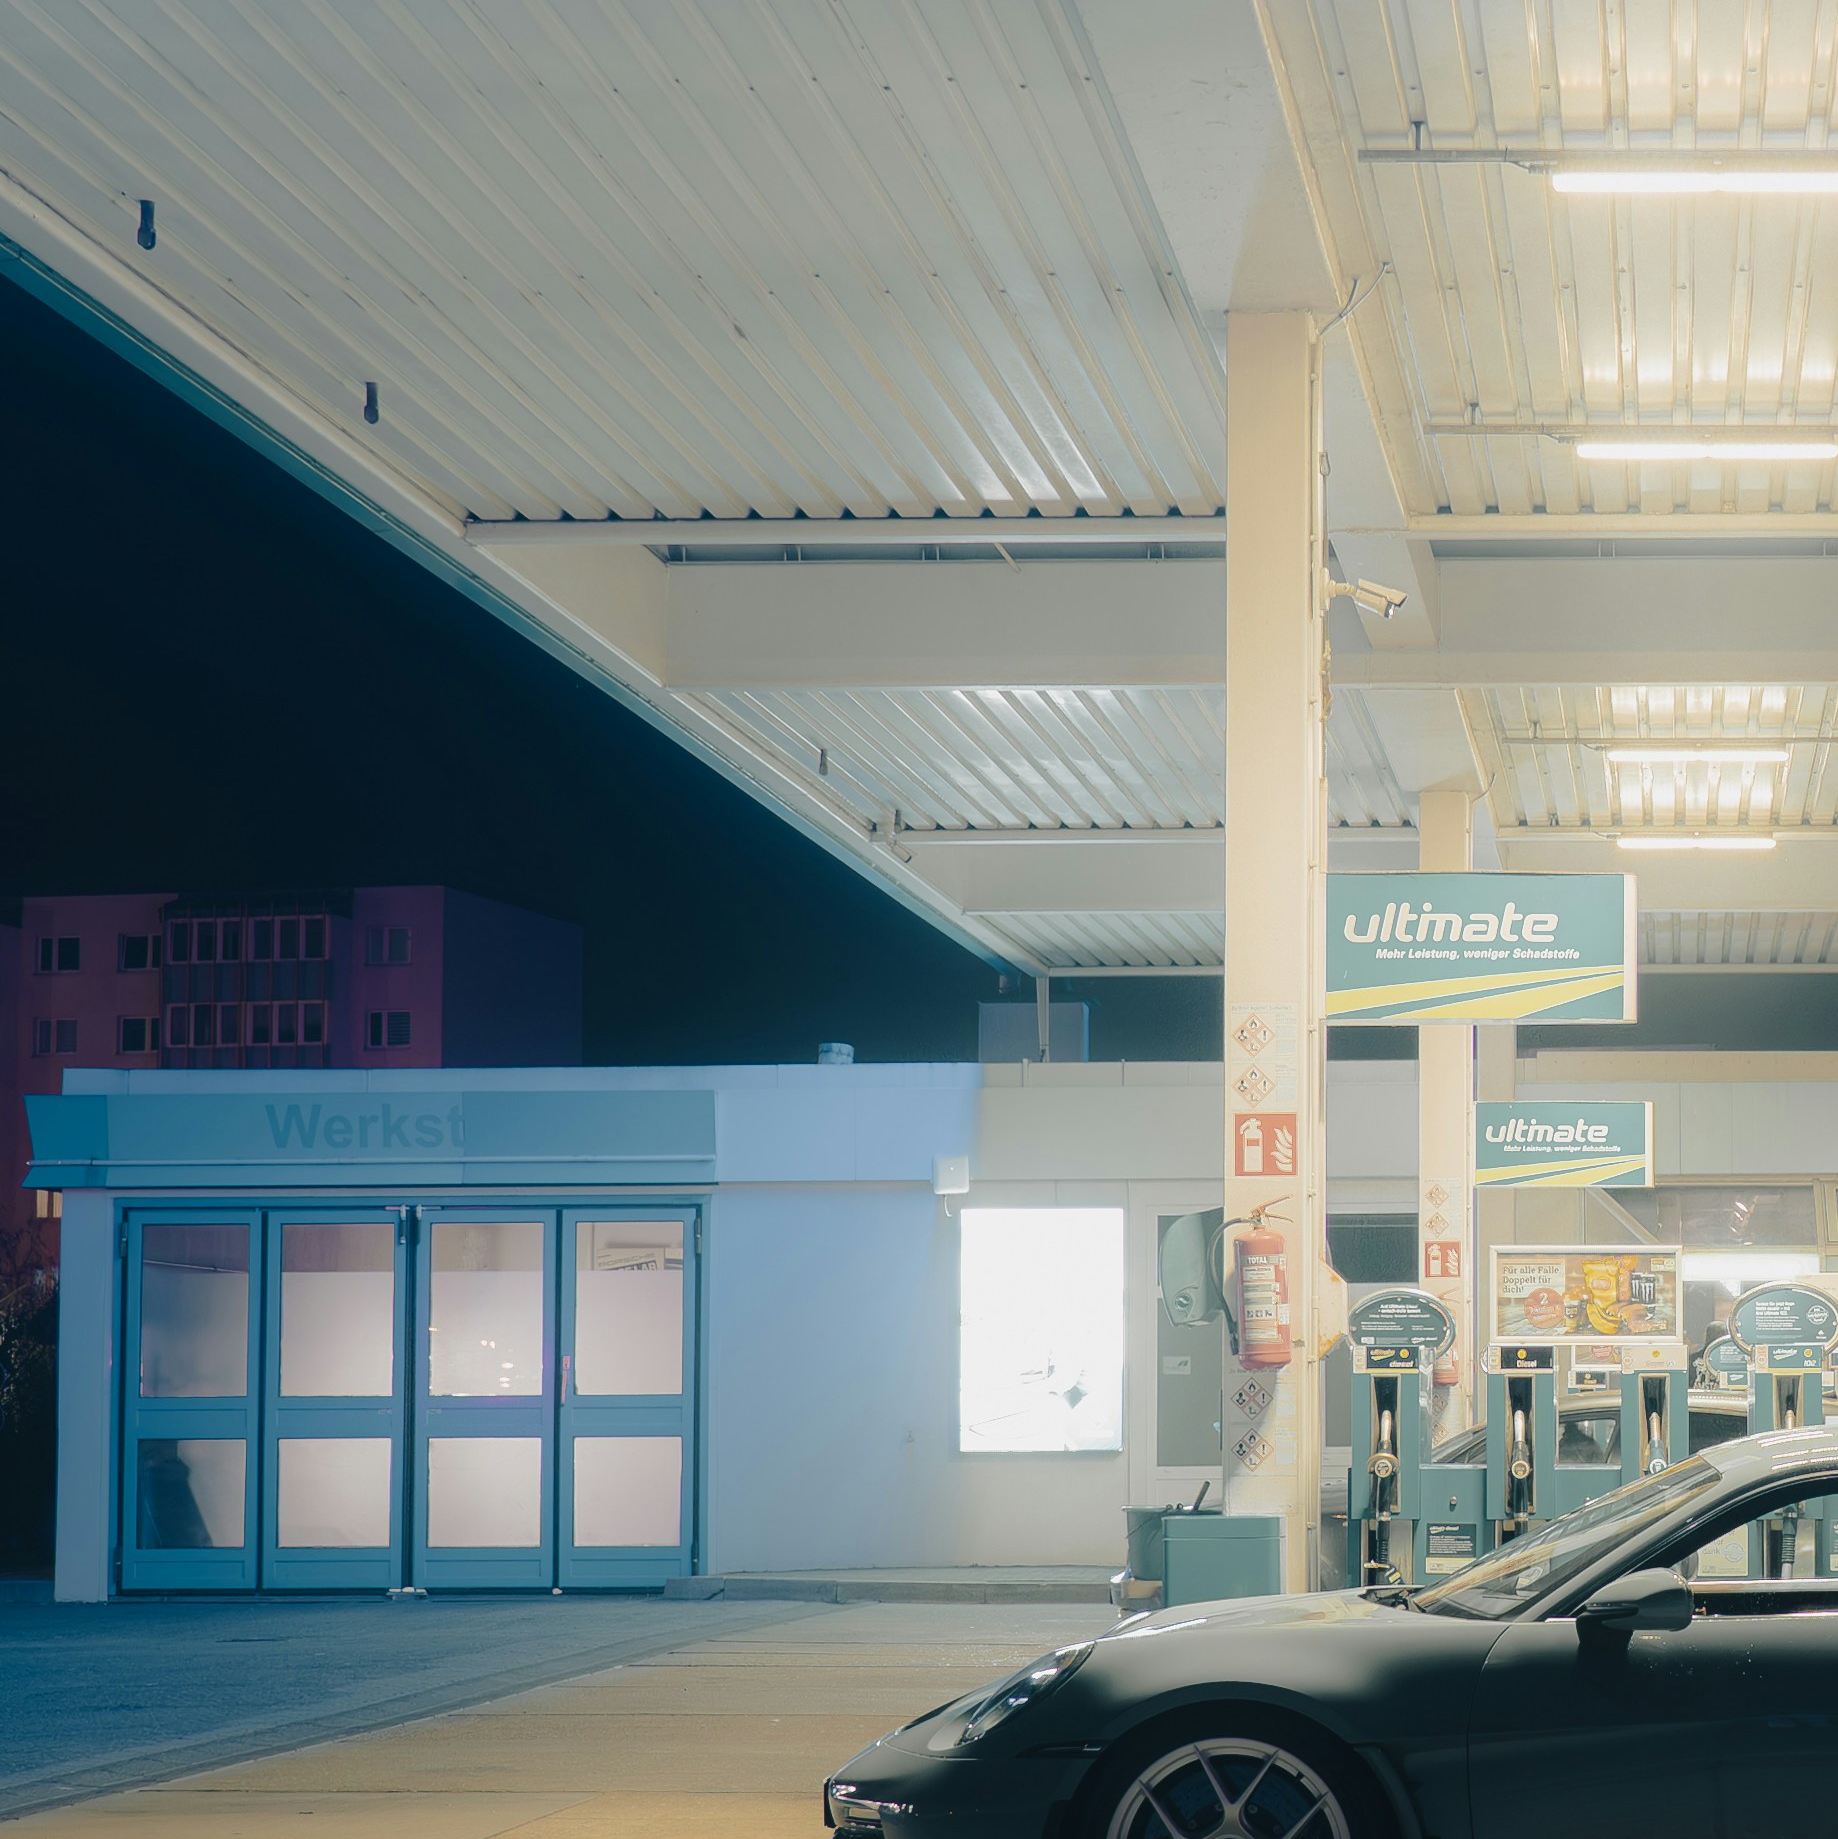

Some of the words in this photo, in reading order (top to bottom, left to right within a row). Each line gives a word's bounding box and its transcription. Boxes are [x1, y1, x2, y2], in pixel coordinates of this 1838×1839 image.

[1343, 902, 1559, 942] ultimate
[1376, 948, 1405, 959] Mehr
[1408, 948, 1460, 960] Leistung,
[1463, 949, 1510, 960] weniger
[1512, 948, 1580, 959] Schadstoffe
[264, 1103, 466, 1149] Werkst
[1486, 1119, 1609, 1143] ultimate
[1248, 1256, 1267, 1264] TOTAL
[1503, 1265, 1517, 1274] Für
[1520, 1265, 1536, 1274] alle
[1503, 1275, 1536, 1285] Doppelt
[1538, 1275, 1552, 1283] für
[1503, 1285, 1525, 1293] dich!
[1516, 1359, 1537, 1368] Diesel
